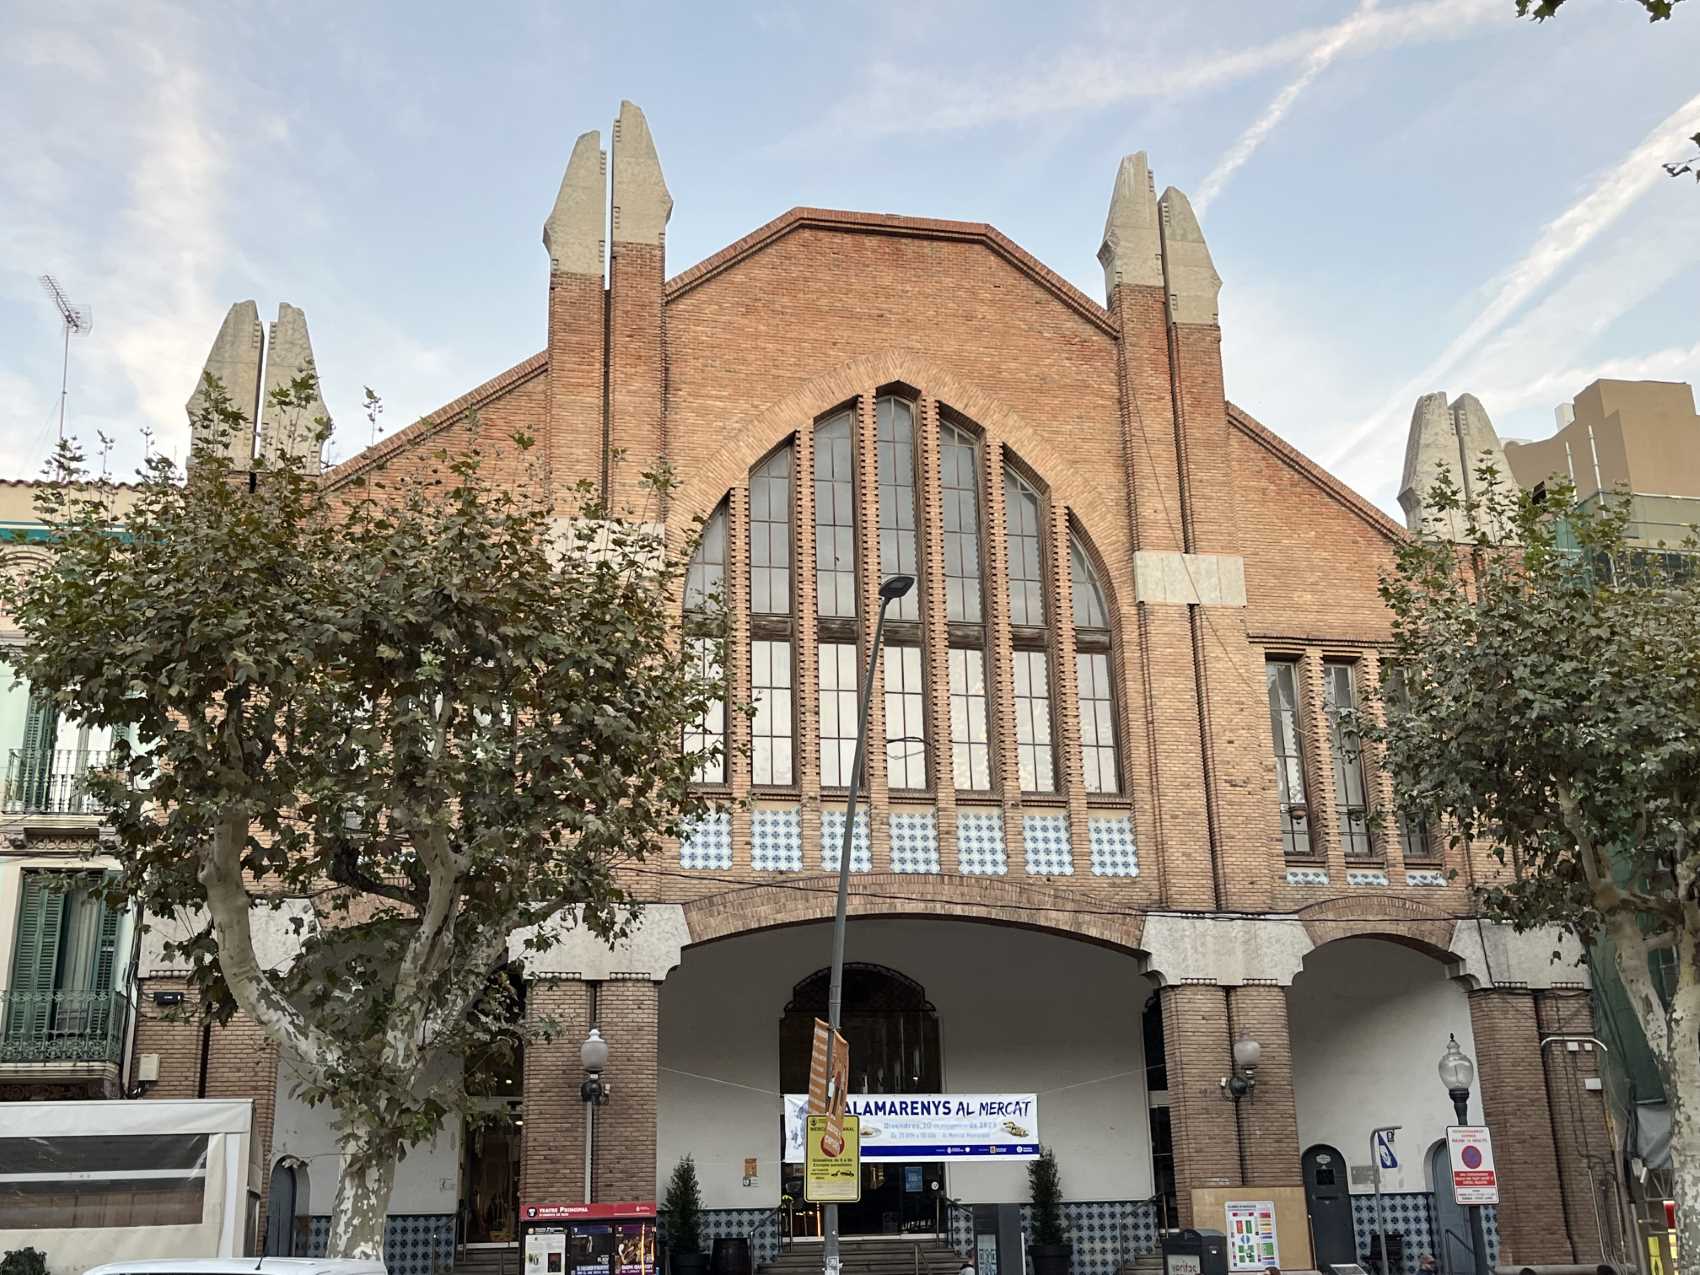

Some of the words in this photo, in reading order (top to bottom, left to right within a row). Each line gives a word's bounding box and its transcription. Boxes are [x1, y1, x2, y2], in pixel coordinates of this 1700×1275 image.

[843, 1100, 952, 1116] ALAMARENYS
[955, 1101, 976, 1118] AL
[978, 1101, 1032, 1118] MERCAT
